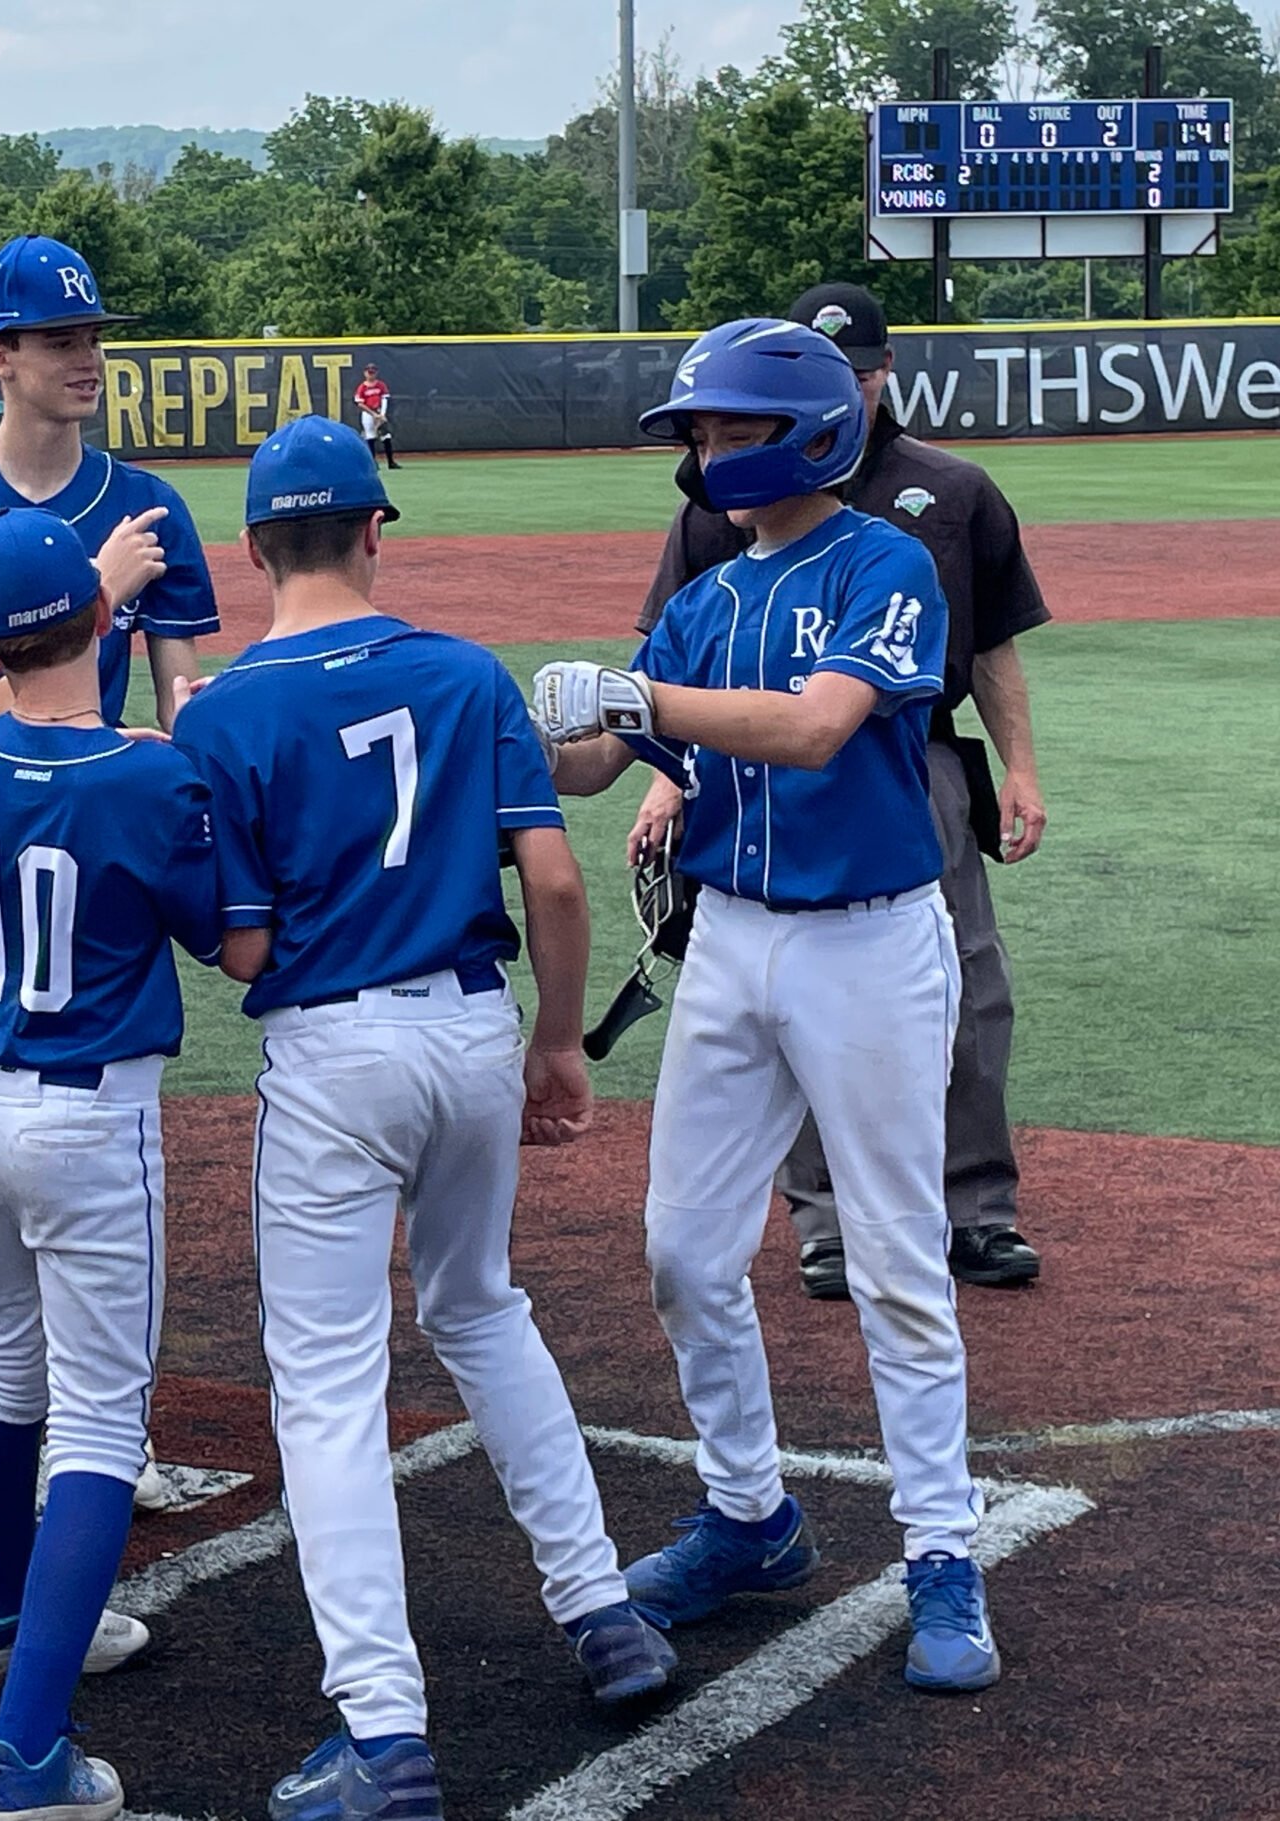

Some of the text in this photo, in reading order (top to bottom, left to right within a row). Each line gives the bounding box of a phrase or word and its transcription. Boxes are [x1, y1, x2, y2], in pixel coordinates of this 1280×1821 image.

[897, 104, 1208, 122] MPH BALL STRIKE OUT TIME
[980, 123, 995, 147] 0
[1041, 123, 1057, 147] 0
[1103, 122, 1118, 146] 2
[975, 153, 983, 164] 2
[893, 163, 1161, 185] RCBC 2 2
[1148, 188, 1161, 207] 0
[56, 266, 96, 304] RC
[106, 354, 352, 448] REPEAT
[271, 486, 333, 511] marucci
[9, 592, 70, 628] marucci
[338, 706, 418, 869] 7
